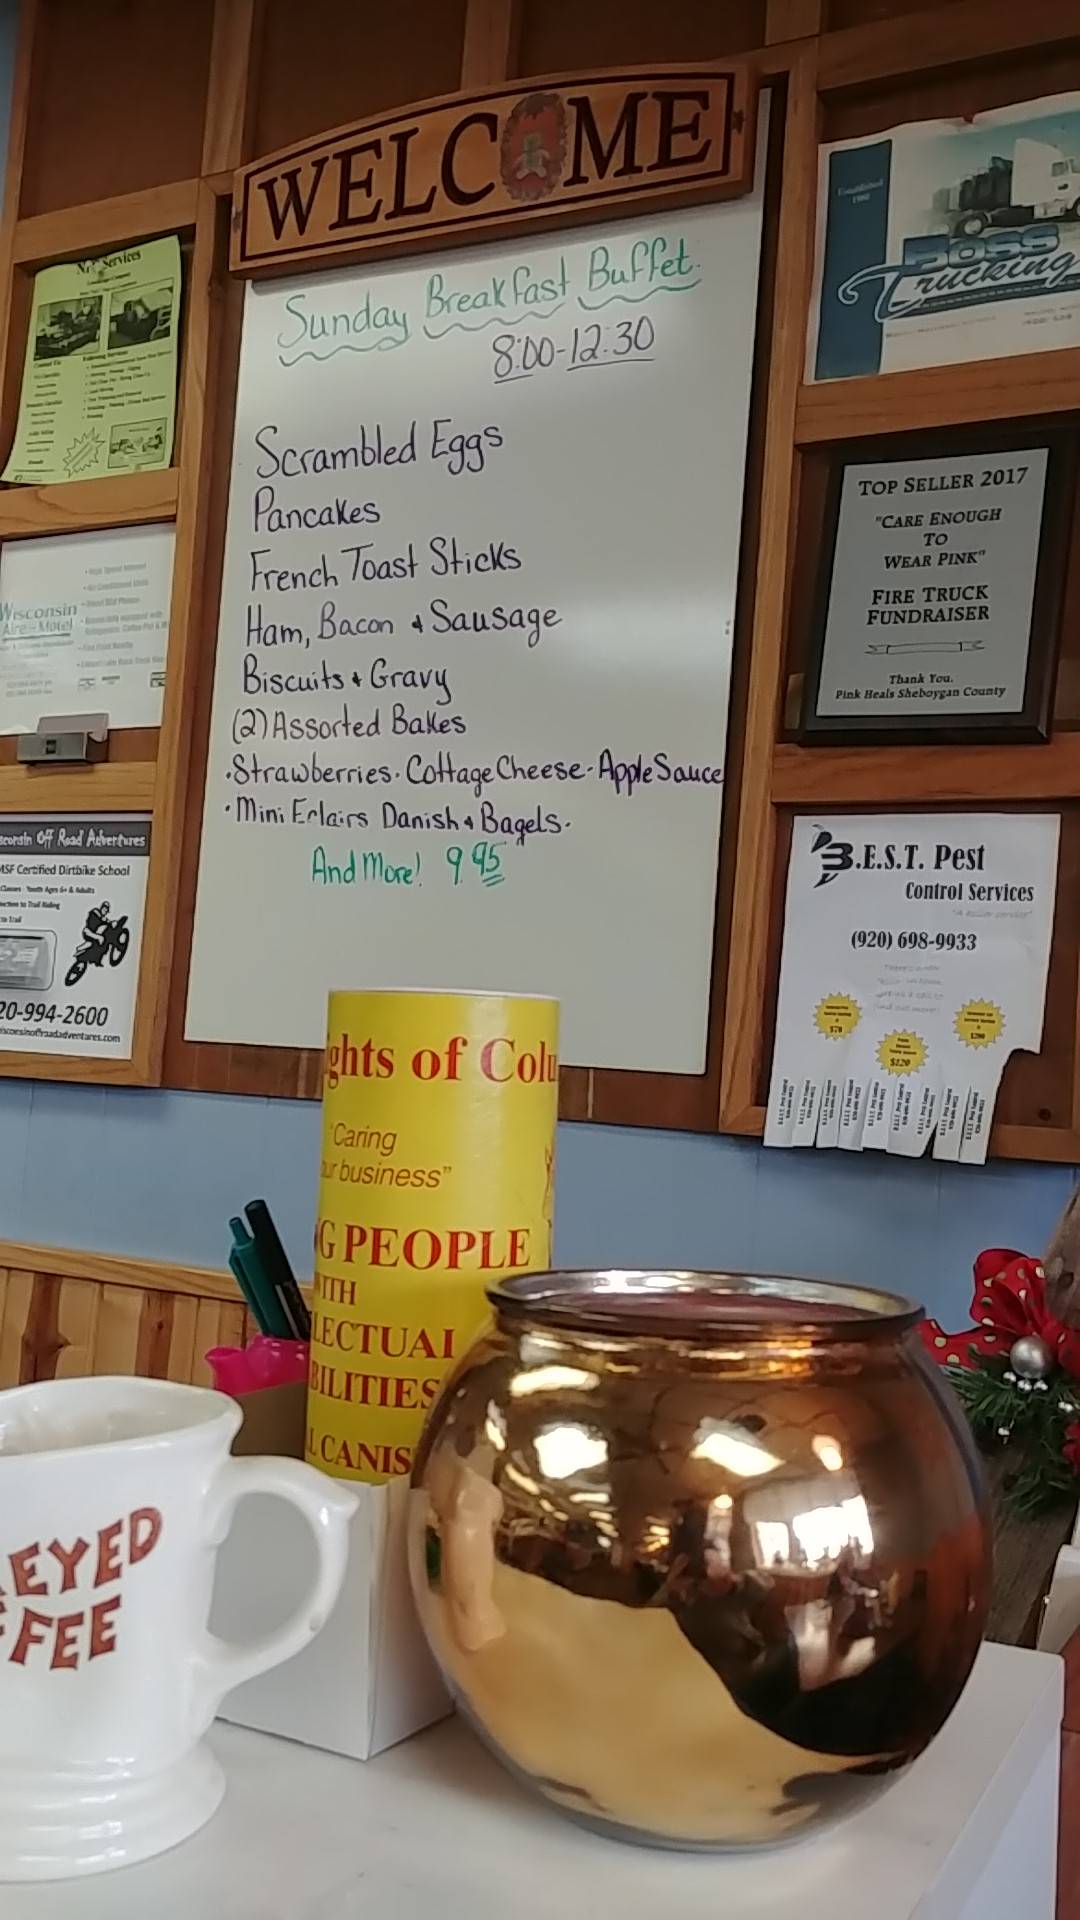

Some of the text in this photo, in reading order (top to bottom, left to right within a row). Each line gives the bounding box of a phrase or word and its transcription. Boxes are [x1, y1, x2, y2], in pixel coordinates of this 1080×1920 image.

[256, 91, 711, 241] WELCME
[277, 293, 409, 348] Sunday
[425, 257, 569, 319] Breakfast
[838, 250, 1080, 323] Trucking
[256, 419, 504, 479] Scrambled Eggs
[858, 466, 1029, 496] TOP SELLER 2017
[254, 486, 381, 532] Pancakes
[929, 508, 1002, 526] ENOUGH
[923, 533, 949, 546] TO
[251, 536, 522, 591] French Toast Sticks
[884, 555, 932, 569] WEAR
[0, 601, 77, 621] Wisconsin
[872, 585, 989, 605] FIRE TRUCK
[246, 604, 311, 649] Ham,
[318, 601, 394, 639] Bacon
[430, 599, 563, 648] Sausage
[867, 605, 990, 625] FUNDRAISER
[243, 653, 345, 694] Biscuits
[370, 658, 453, 705] Gravy
[836, 686, 1006, 700] Pink Heals Sheboygan County
[889, 673, 925, 685] Thank
[391, 703, 467, 735] Bakes
[405, 750, 495, 797] Cottage
[235, 797, 285, 825] Mini
[382, 802, 460, 831] Danish
[57, 828, 84, 847] Road
[17, 864, 56, 875] Certified
[59, 865, 96, 875] Dirtbike
[98, 865, 130, 876] School
[311, 846, 357, 885] And
[362, 850, 422, 888] More!
[934, 843, 986, 871] Pest
[905, 881, 1035, 901] Control Services
[851, 931, 977, 951] (920) 698-9933
[324, 1033, 394, 1090] ghts
[412, 1036, 468, 1081] of
[343, 1224, 531, 1271] PEOPLE
[0, 1506, 163, 1597] EYED
[0, 1594, 122, 1671] FEE
